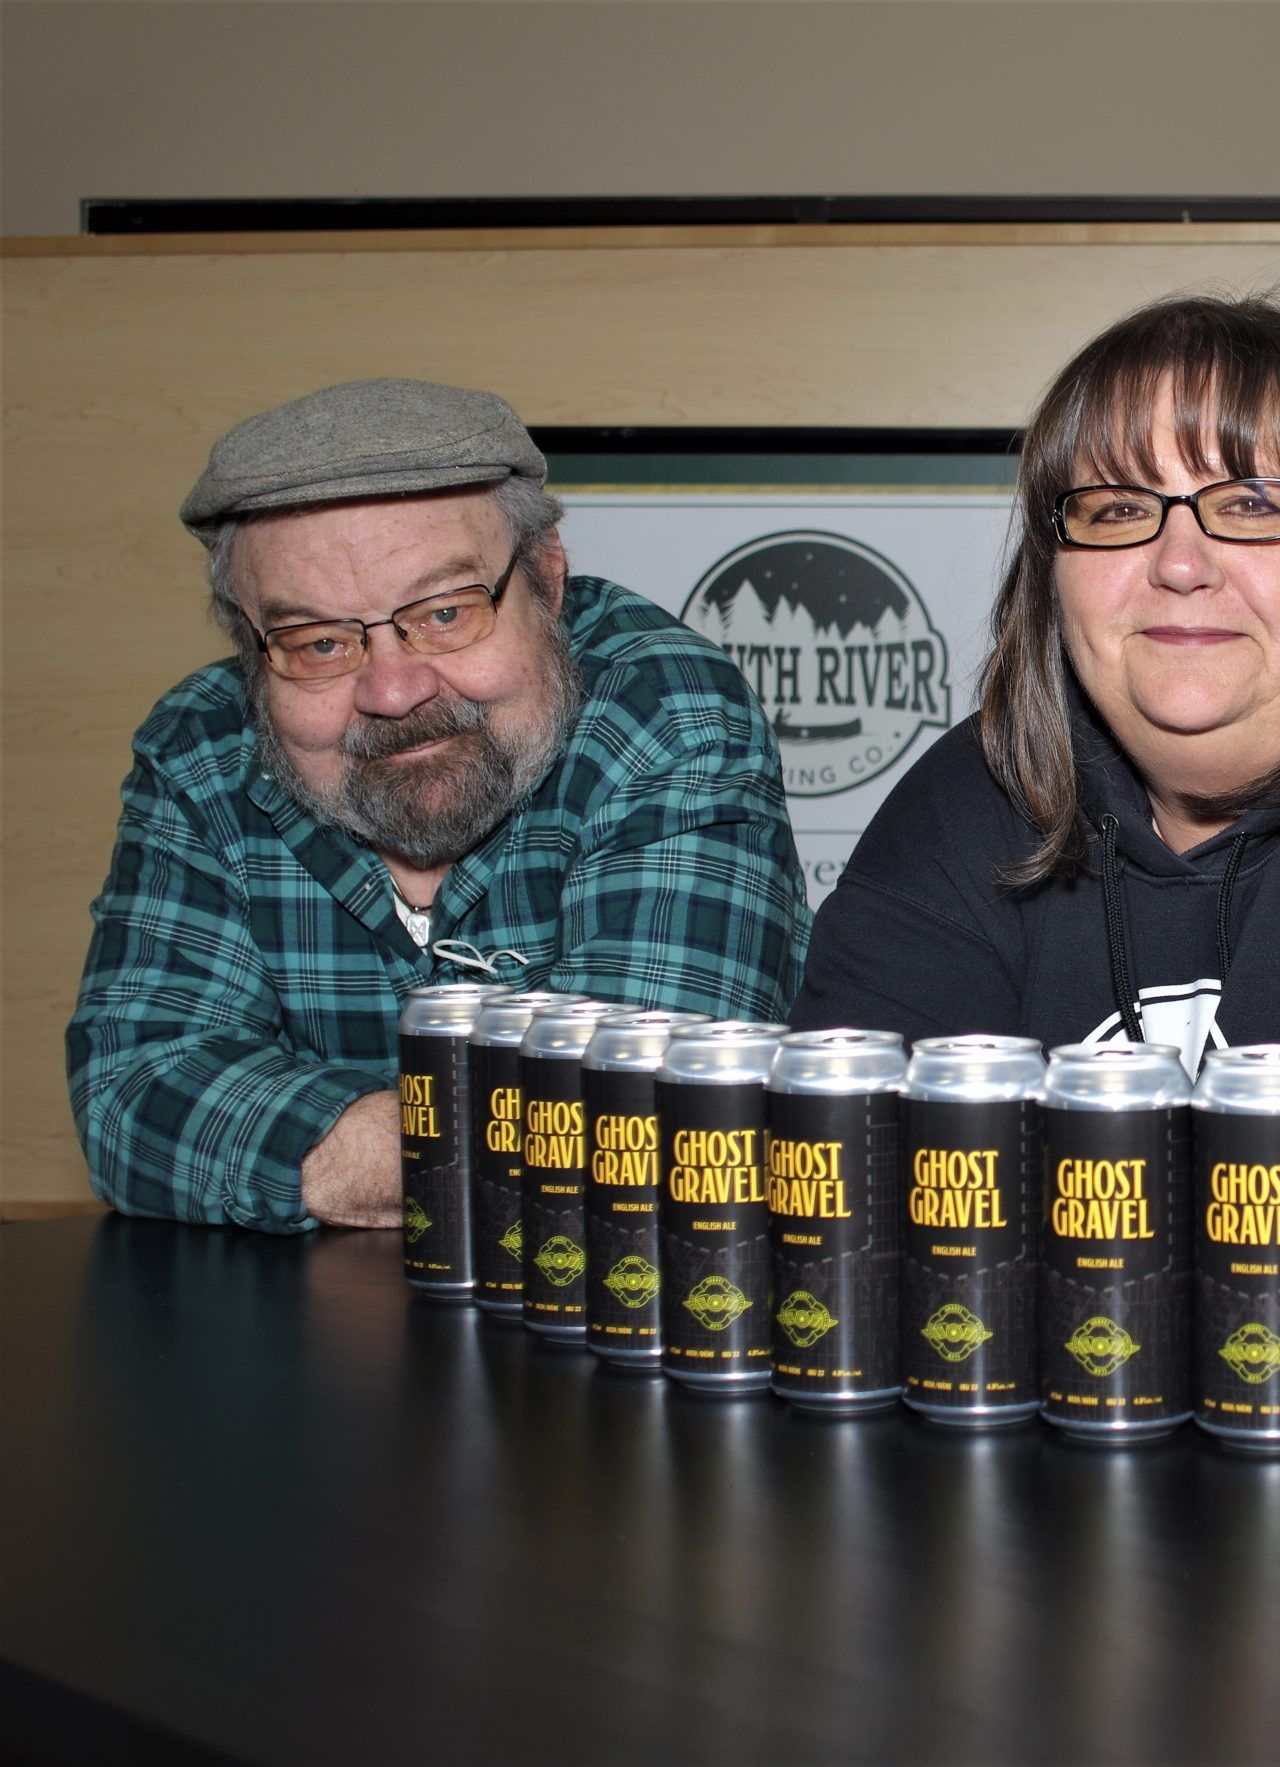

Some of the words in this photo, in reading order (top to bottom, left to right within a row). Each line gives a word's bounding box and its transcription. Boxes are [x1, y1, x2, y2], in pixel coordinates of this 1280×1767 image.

[816, 639, 938, 714] RIVER
[402, 1105, 440, 1137] AVEL
[528, 1101, 583, 1135] GHOS
[596, 1115, 658, 1150] GHOS
[525, 1134, 583, 1169] GRAV
[674, 1130, 757, 1167] GHOST
[768, 1140, 842, 1180] GHOST
[592, 1150, 658, 1186] GRAV
[670, 1166, 765, 1204] GRAVEL
[914, 1149, 998, 1189] GHOST
[1057, 1159, 1147, 1200] GHOST
[542, 1185, 564, 1193] ENGLISH
[767, 1175, 851, 1218] GRAVEL
[613, 1203, 638, 1211] ENGLISH
[640, 1204, 653, 1212] ALE
[910, 1186, 1007, 1228] GRAVEL
[1053, 1197, 1154, 1240] GRAVEL
[693, 1222, 721, 1230] ENGLISH
[722, 1222, 736, 1231] ALE
[784, 1234, 807, 1244] ENGLISH
[808, 1236, 821, 1245] ALE
[932, 1246, 960, 1256] ENGLISH
[961, 1247, 976, 1256] ALE
[1077, 1258, 1107, 1268] ENGLISH
[1108, 1259, 1124, 1269] ALE
[1231, 1263, 1261, 1274] ENGLISH
[1262, 1265, 1278, 1275] ALE
